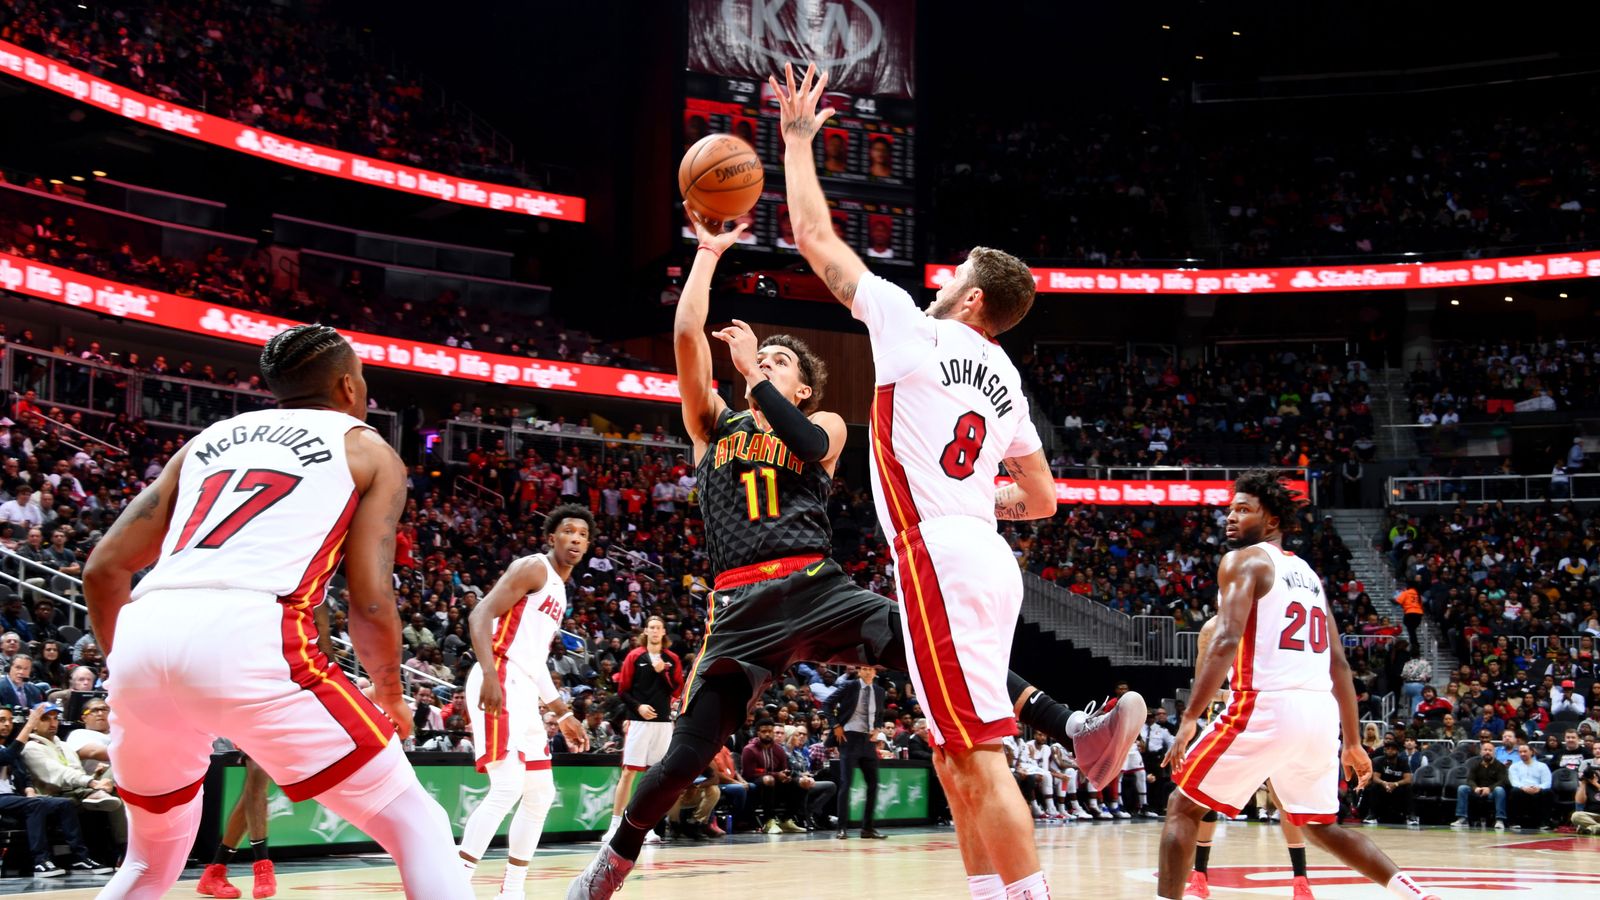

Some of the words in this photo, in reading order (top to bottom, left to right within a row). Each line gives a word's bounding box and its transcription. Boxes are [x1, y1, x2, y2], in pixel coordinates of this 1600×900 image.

[24, 57, 47, 80] to
[48, 64, 89, 99] help
[90, 80, 120, 108] life
[122, 97, 146, 118] go
[148, 103, 201, 133] right.
[352, 158, 395, 184] Here
[397, 171, 417, 189] to
[418, 173, 456, 201] help
[457, 182, 488, 203] life
[489, 192, 513, 210] go
[515, 192, 563, 216] right.
[714, 158, 761, 184] PALDING
[26, 265, 62, 296] life
[65, 282, 94, 306] go
[96, 285, 157, 317] right.
[1050, 272, 1095, 289] Here
[1097, 274, 1118, 290] to
[1120, 273, 1161, 293] help
[1163, 273, 1193, 289] life
[1195, 278, 1219, 293] go
[1223, 272, 1276, 293] right.
[1419, 266, 1470, 284] Here
[1472, 265, 1496, 281] to
[1498, 260, 1545, 280] help
[1547, 256, 1584, 276] life
[347, 335, 385, 361] ere
[387, 345, 411, 365] to
[413, 347, 457, 376] help
[459, 353, 491, 377] life
[493, 363, 520, 384] go
[522, 363, 578, 389] right.
[939, 358, 1013, 419] JOHNSON
[194, 424, 333, 468] McGRUDER
[939, 410, 987, 481] 8
[169, 468, 304, 557] 17
[740, 467, 781, 522] 11
[1055, 483, 1096, 501] Here
[1098, 485, 1121, 501] to
[1123, 484, 1166, 505] help
[1169, 484, 1201, 502] life
[1204, 488, 1230, 505] go
[1278, 600, 1329, 654] 20
